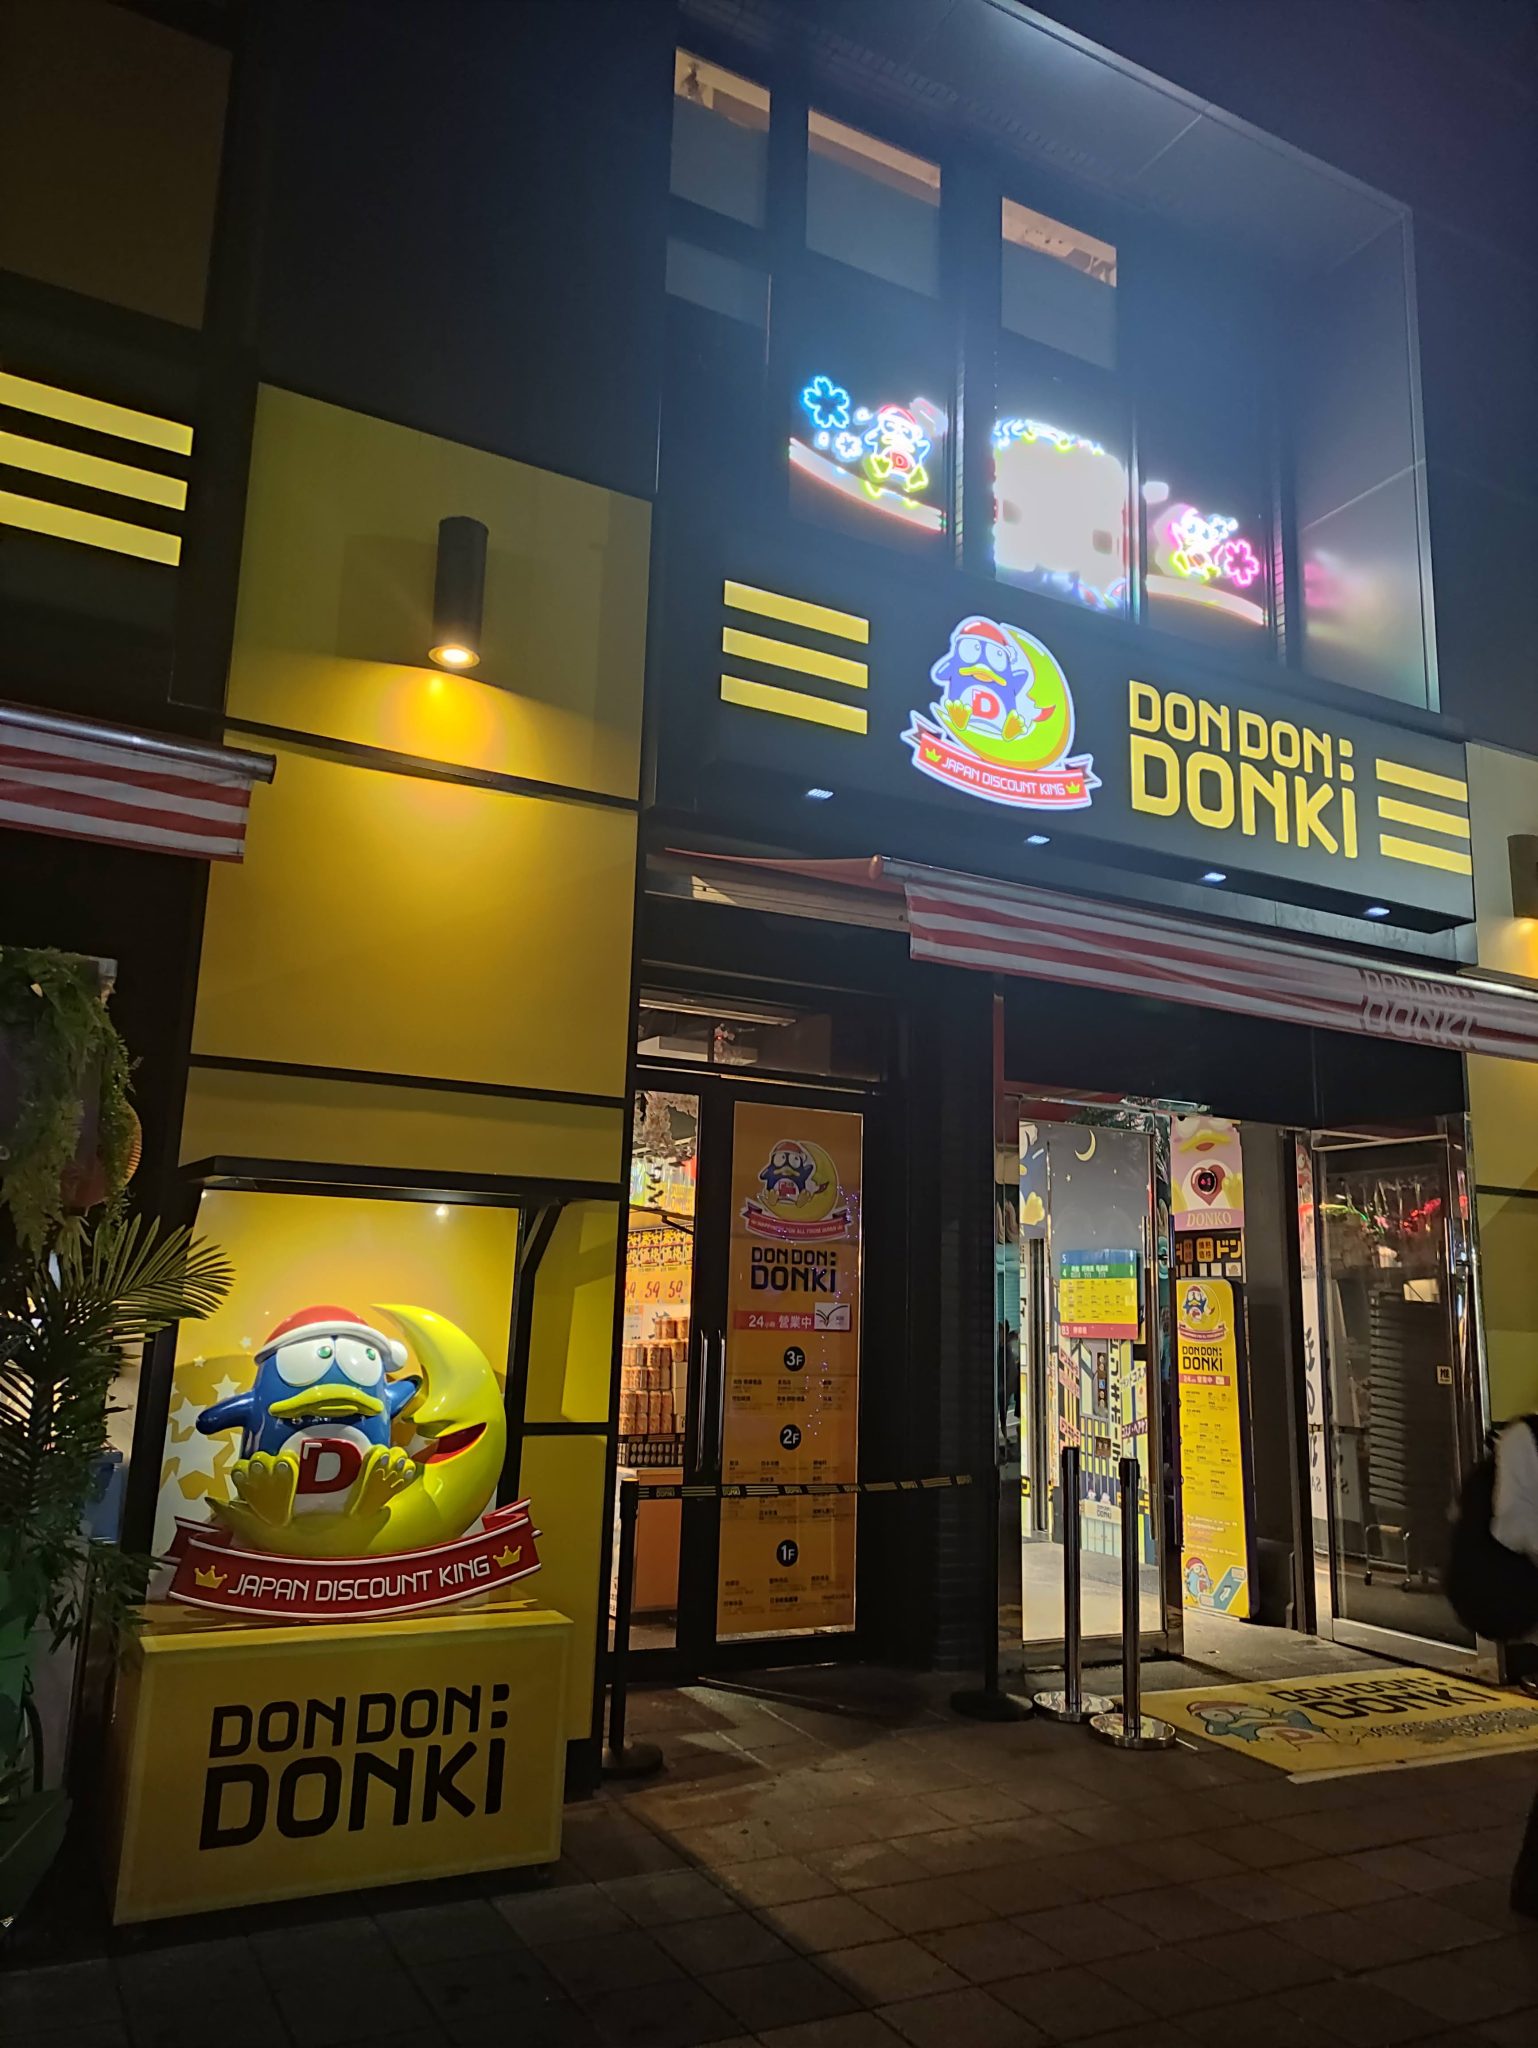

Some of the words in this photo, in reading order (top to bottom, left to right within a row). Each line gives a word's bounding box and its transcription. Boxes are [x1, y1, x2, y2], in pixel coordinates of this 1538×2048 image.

[941, 757, 980, 782] JAPAN
[982, 773, 1036, 794] DISCOUNT
[1039, 782, 1066, 796] KING
[1130, 735, 1359, 859] DONKI
[1363, 997, 1474, 1049] DONKI
[1186, 1212, 1232, 1227] DONKO
[751, 1265, 837, 1293] DONKI
[786, 1350, 803, 1366] 3F
[1183, 1356, 1223, 1372] DONKI
[783, 1429, 799, 1444] 2F
[780, 1544, 795, 1561] 1F
[228, 1573, 310, 1601] JAPAN
[315, 1570, 431, 1602] DISCOUNT
[438, 1555, 491, 1588] KING
[1298, 1686, 1501, 1720] DONKI
[199, 1737, 506, 1851] DONKI
